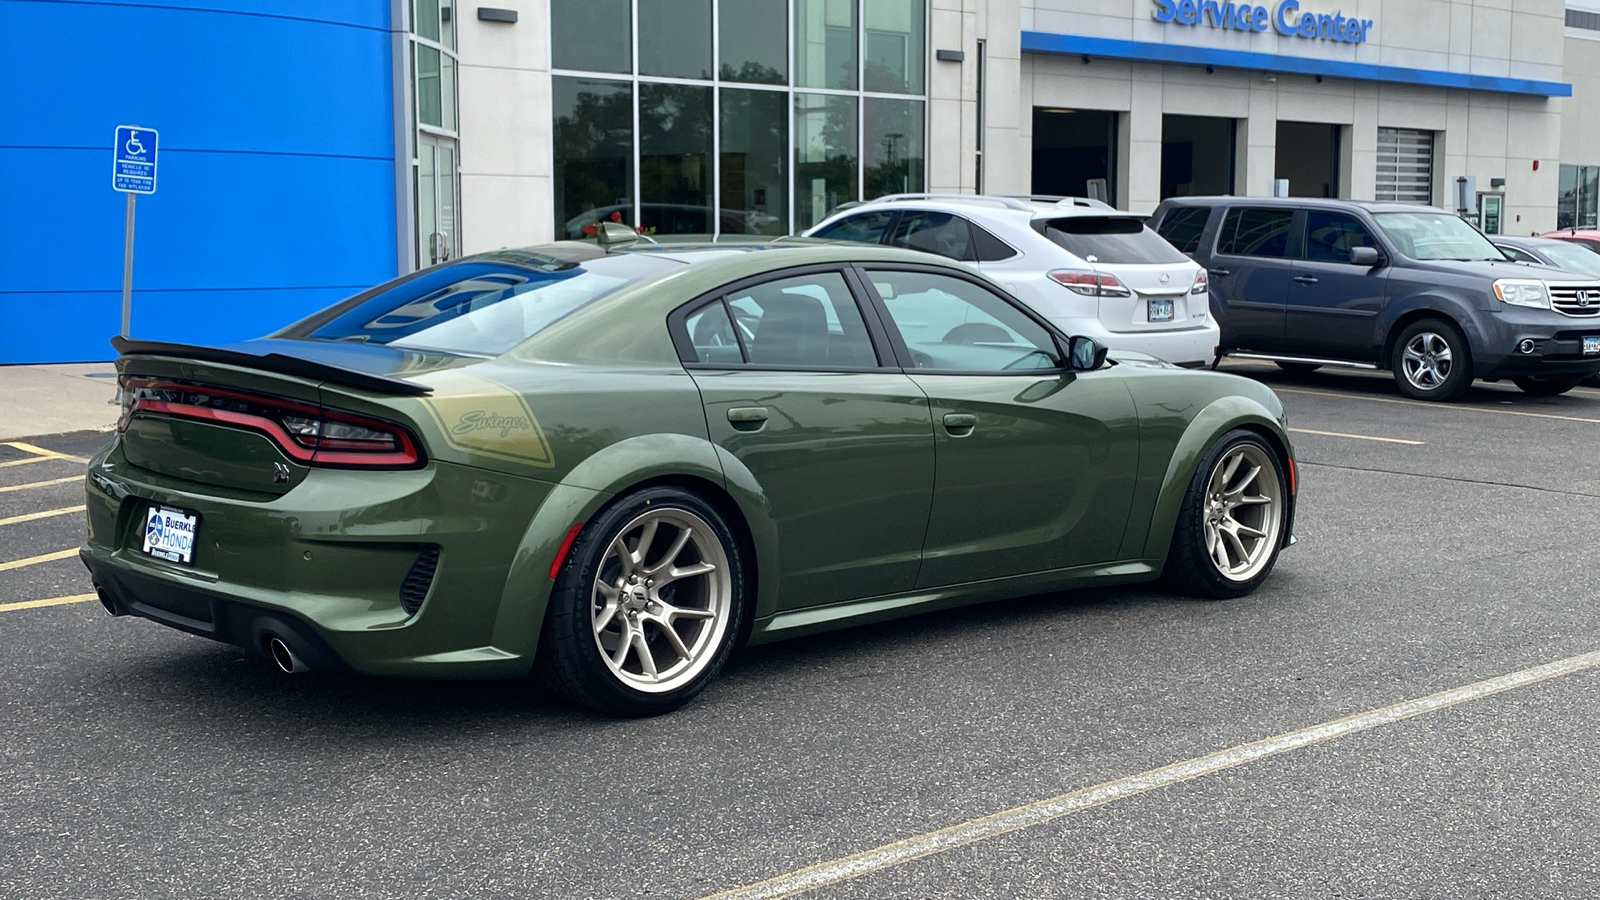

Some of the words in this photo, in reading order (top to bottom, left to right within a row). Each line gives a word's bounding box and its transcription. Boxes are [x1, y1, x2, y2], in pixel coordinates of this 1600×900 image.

[1152, 0, 1268, 32] Service
[1272, 0, 1373, 43] Center
[121, 163, 142, 171] VEHICLE
[125, 154, 147, 162] PARKING
[452, 410, 529, 438] Swinger
[165, 516, 196, 533] BUERKLE
[162, 528, 194, 551] HONDA
